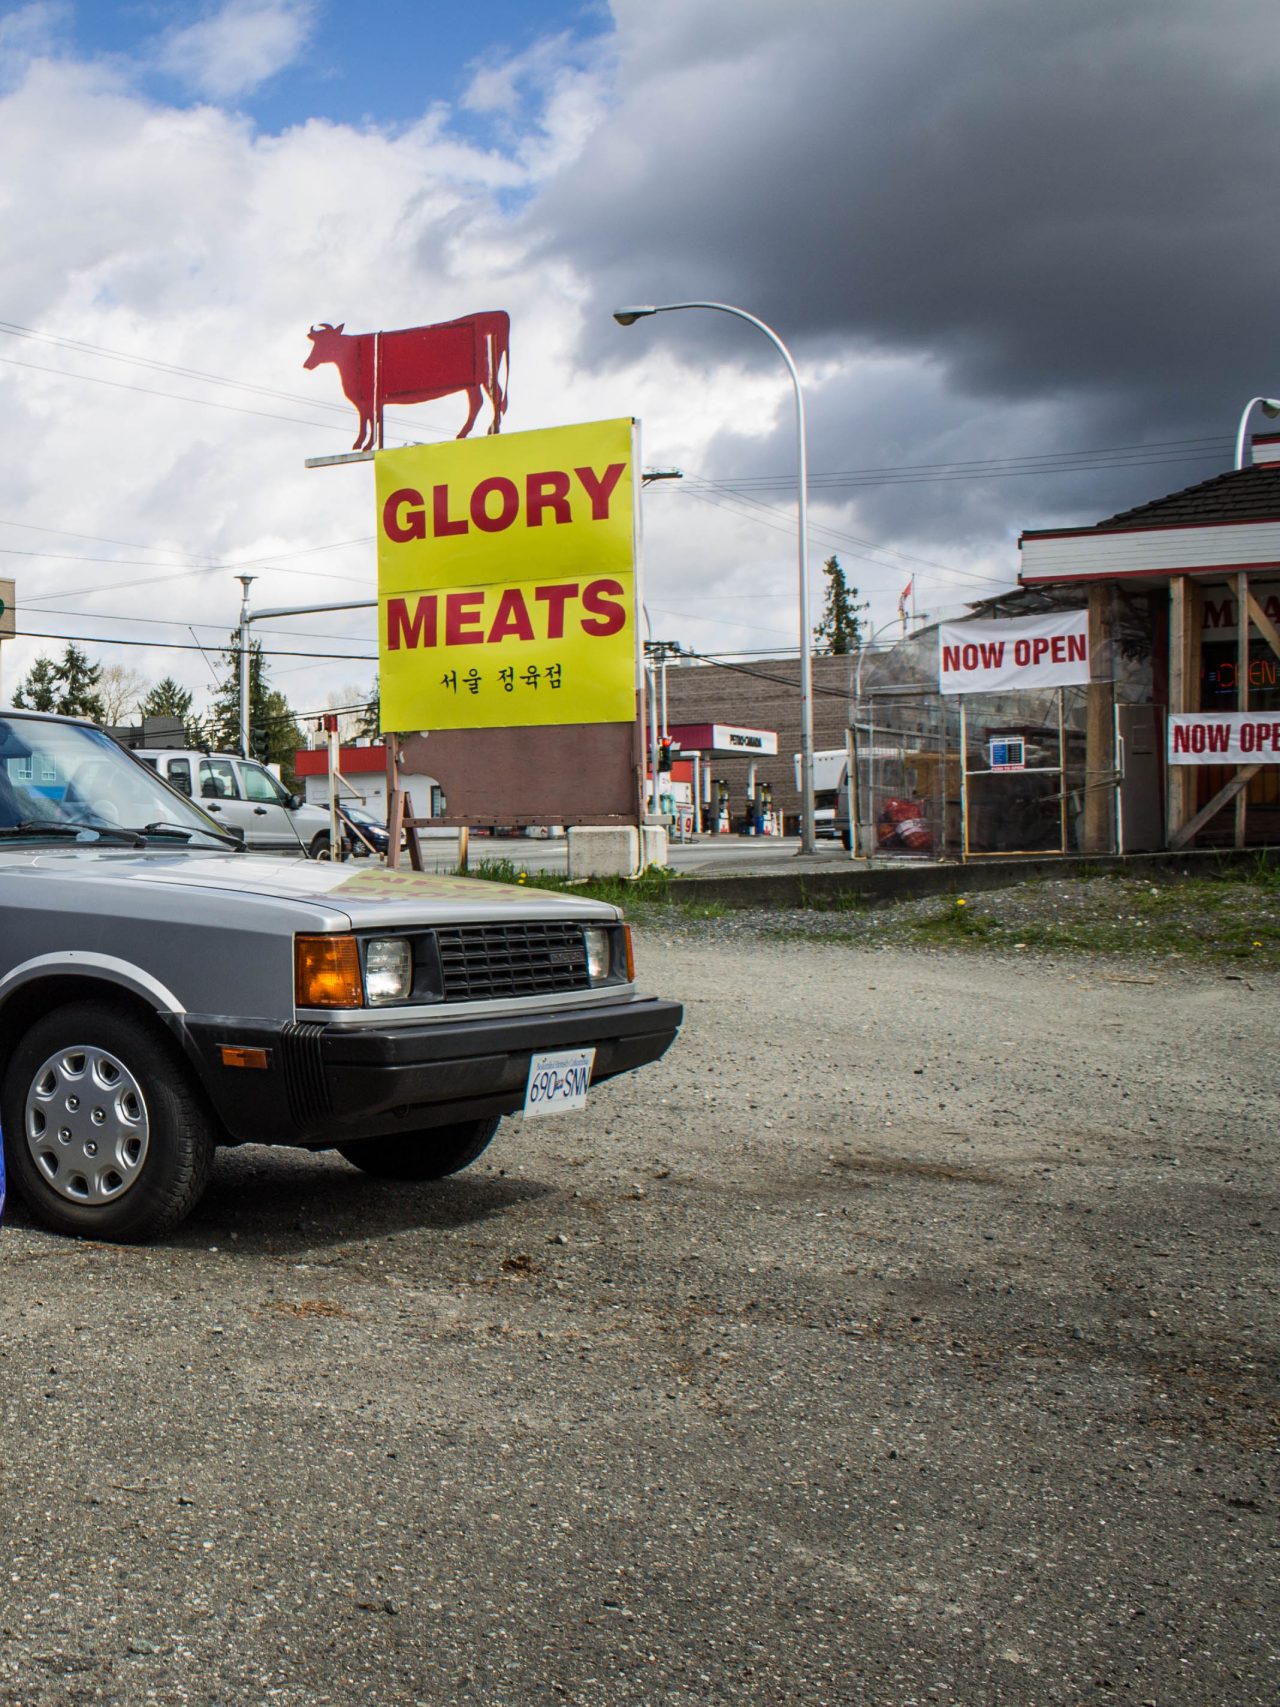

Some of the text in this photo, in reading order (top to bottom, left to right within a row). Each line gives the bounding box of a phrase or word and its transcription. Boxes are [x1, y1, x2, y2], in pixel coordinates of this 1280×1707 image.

[382, 463, 627, 544] GLORY
[386, 578, 627, 651] MEATS
[942, 634, 1087, 673] NOW OPEN
[440, 663, 562, 695] 서울 정육점
[1173, 724, 1231, 753] NOW
[530, 1070, 558, 1102] 690
